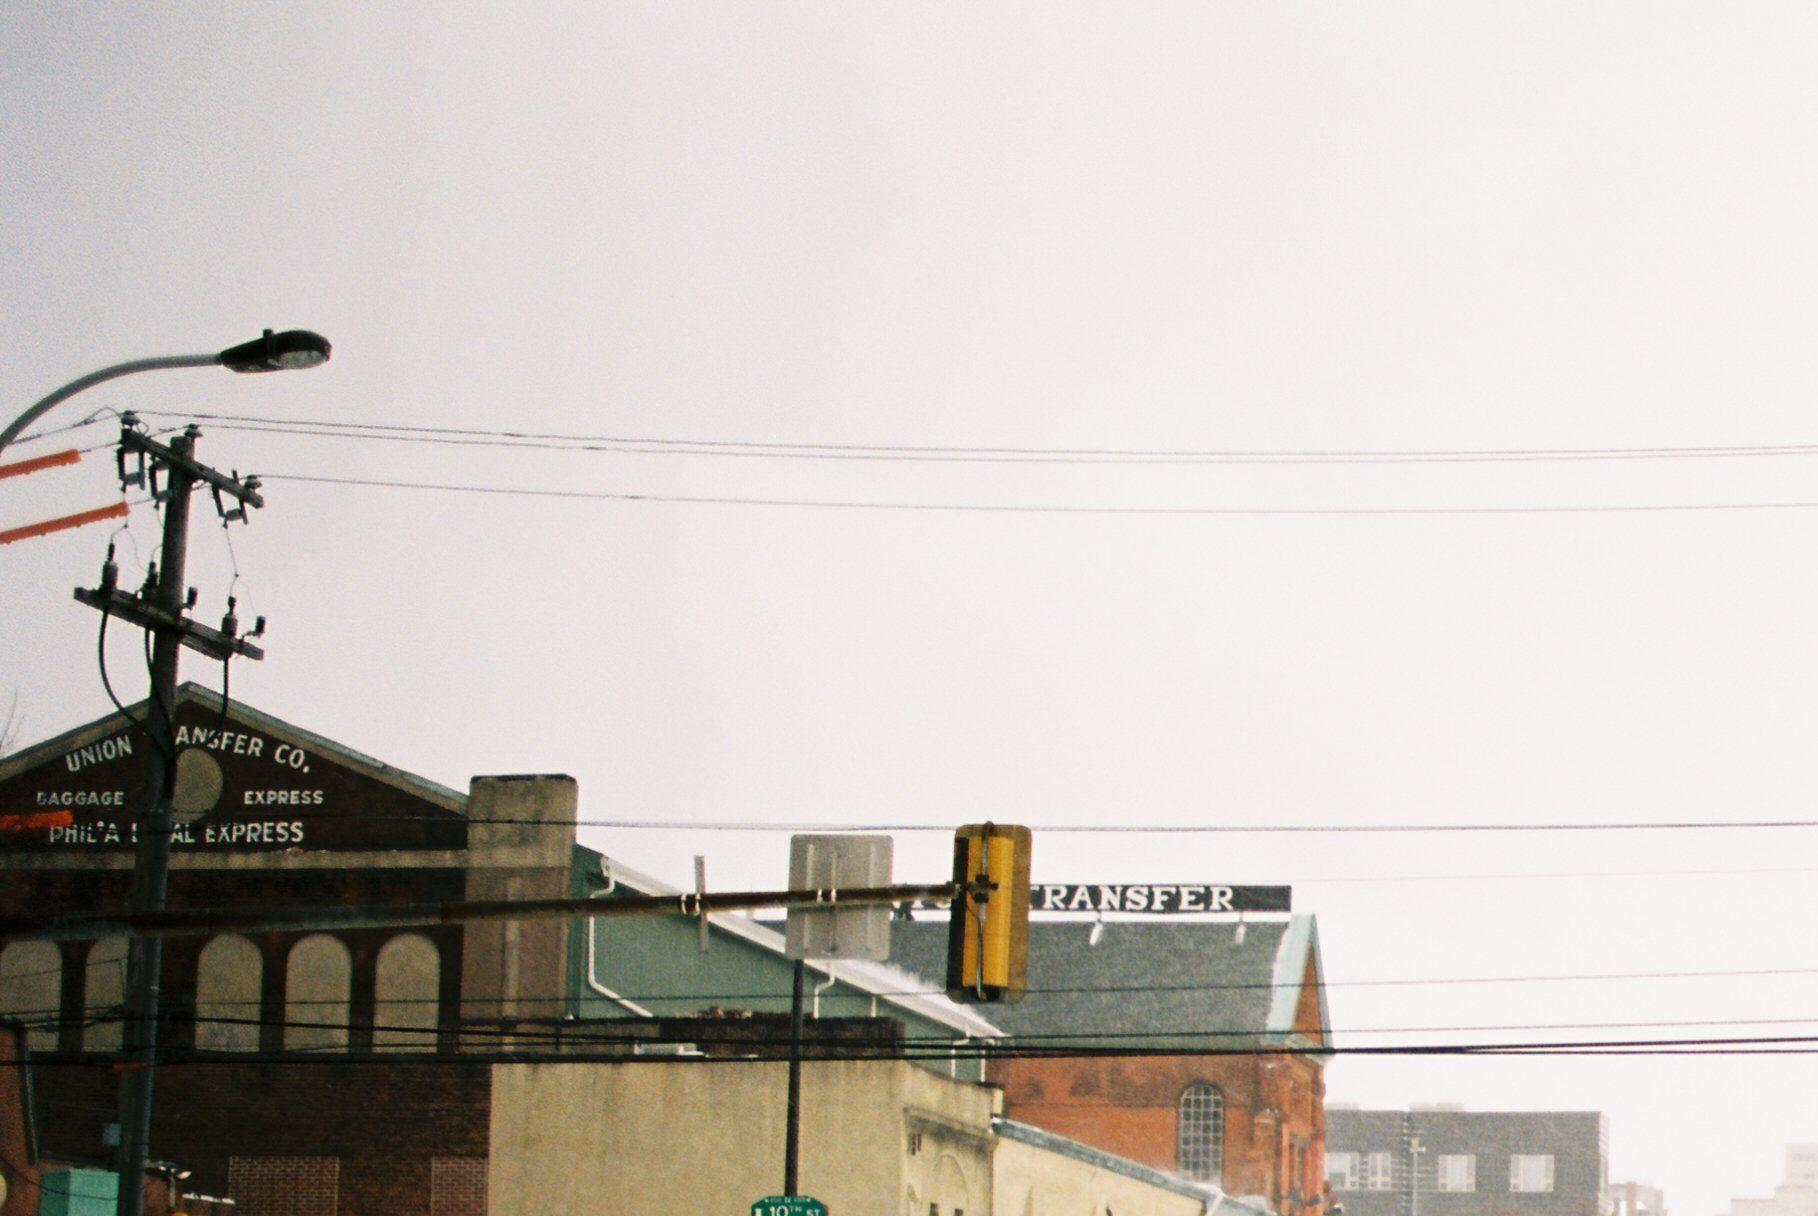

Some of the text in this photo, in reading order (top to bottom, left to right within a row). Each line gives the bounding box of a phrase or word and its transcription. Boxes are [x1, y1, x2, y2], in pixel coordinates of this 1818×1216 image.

[65, 725, 310, 773] UNION ANSFER CO.
[36, 790, 324, 806] BAGGAGE EXPRESS
[205, 822, 304, 843] EXPRESS
